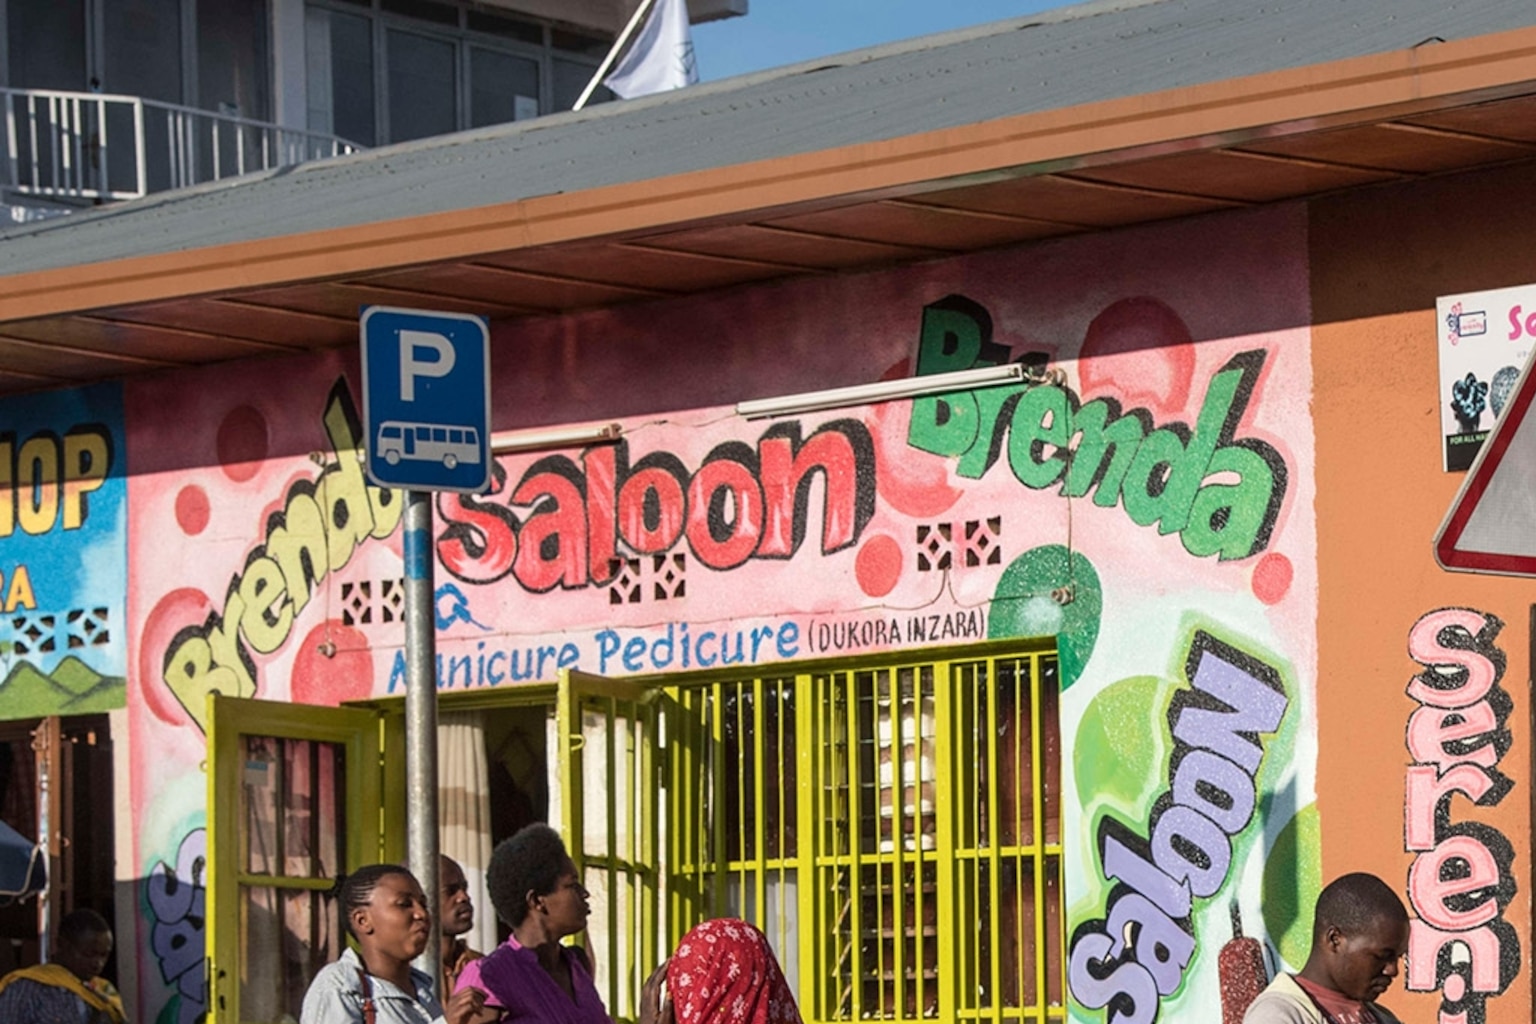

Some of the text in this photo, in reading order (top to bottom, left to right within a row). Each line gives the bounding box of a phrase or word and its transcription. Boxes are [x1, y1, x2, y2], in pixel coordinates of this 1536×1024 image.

[399, 330, 456, 401] P
[907, 294, 1292, 563] Brenda
[595, 620, 800, 674] Pedicure
[808, 616, 900, 654] (DUKORA
[906, 606, 985, 643] INZARA)
